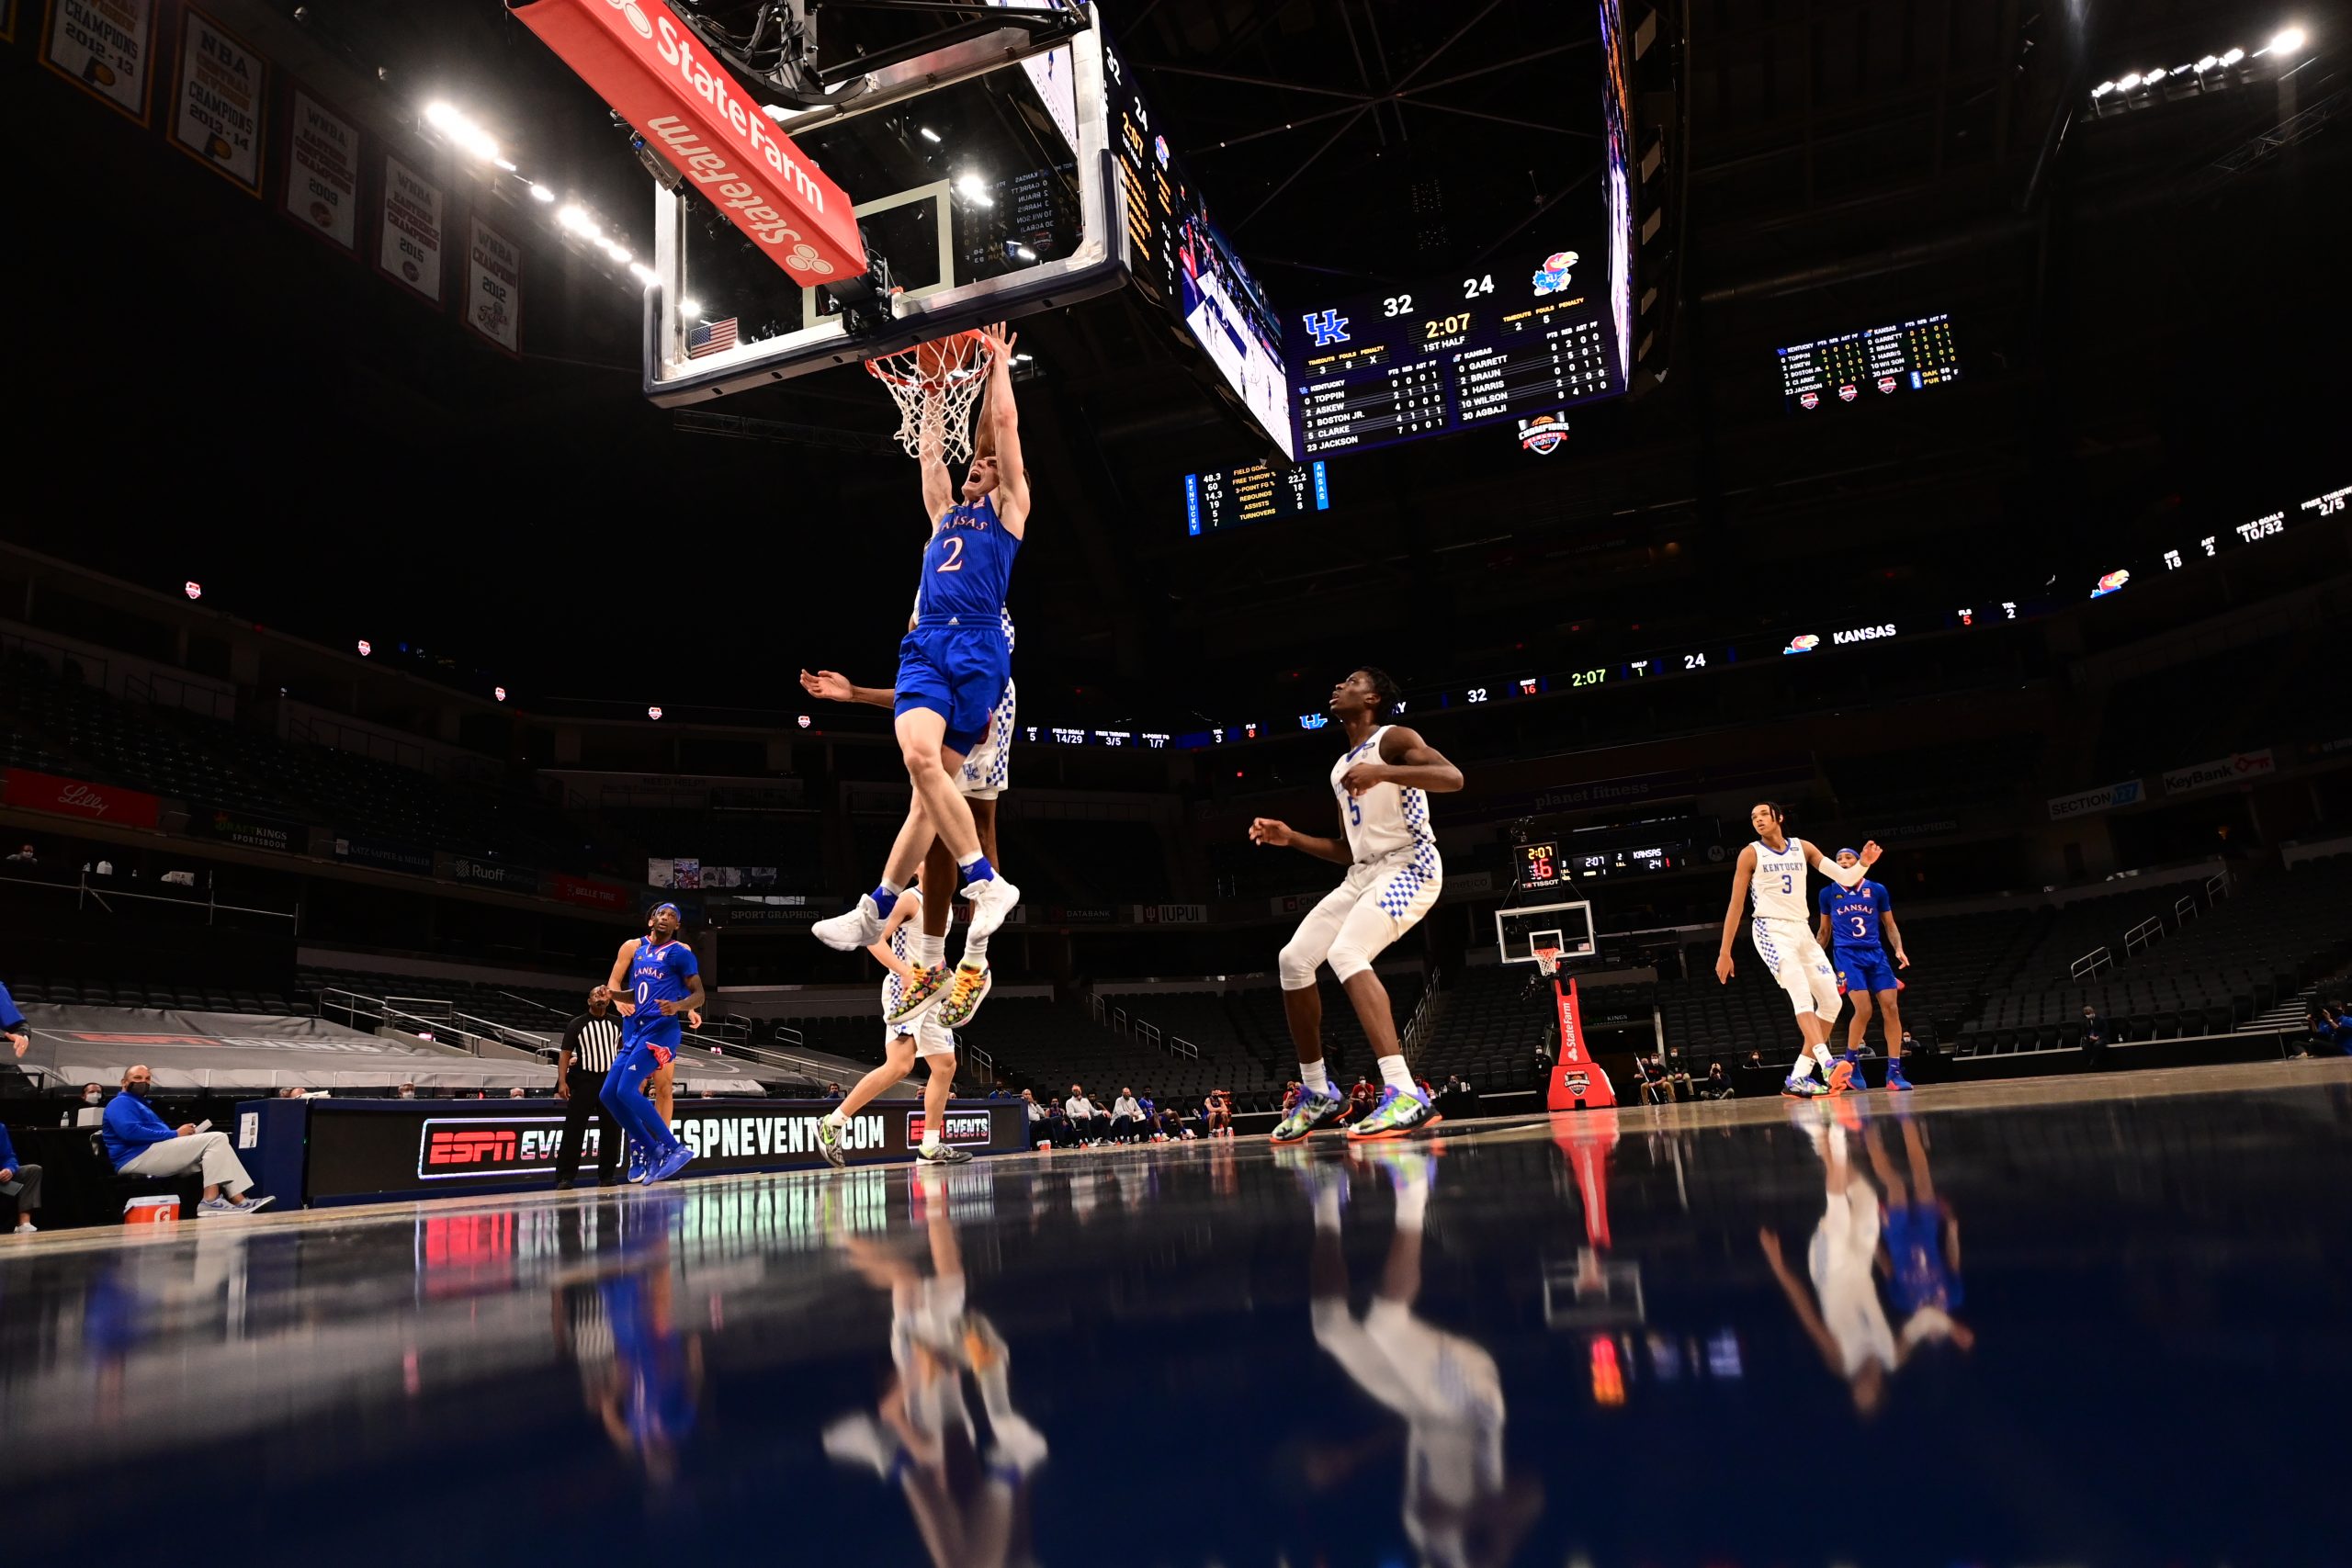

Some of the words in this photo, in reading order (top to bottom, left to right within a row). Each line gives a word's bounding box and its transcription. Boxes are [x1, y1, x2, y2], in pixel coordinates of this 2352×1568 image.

[65, 0, 138, 59] CHAMPIONS
[65, 22, 106, 59] 2012
[201, 30, 249, 80] NBA
[189, 81, 253, 134] CHAMPIONS
[190, 104, 223, 134] 2013
[1464, 275, 1495, 299] 24
[1383, 294, 1414, 318] 32
[1503, 311, 1532, 322] TIMEOUTS
[1535, 305, 1555, 314] FOULS
[1558, 298, 1584, 309] PENALTY
[1425, 313, 1470, 339] 2:07
[1515, 322, 1522, 331] 2
[1424, 342, 1440, 353] 1ST
[1442, 336, 1465, 348] HALF
[1464, 347, 1493, 359] KANSAS
[1308, 355, 1335, 366] TIMEOUTS
[1361, 345, 1384, 355] PENALTY
[1469, 355, 1508, 370] GARRETT
[1319, 366, 1326, 375] 3
[1471, 369, 1501, 382] BRAUN
[1310, 379, 1345, 392] KENTUCKY
[1472, 380, 1505, 394] HARRIS
[1315, 391, 1345, 403] TOPPIN
[1462, 400, 1472, 409] 10
[1474, 392, 1508, 406] WILSON
[1316, 402, 1345, 414] ASKEW
[1463, 412, 1474, 421] 30
[1476, 404, 1507, 418] AGBAJI
[1317, 413, 1351, 426] BOSTON
[1352, 411, 1365, 419] JR.
[1318, 425, 1351, 438] CLARKE
[1307, 444, 1317, 452] 23
[1319, 435, 1359, 449] JACKSON
[1232, 477, 1248, 485] FREE
[1249, 473, 1270, 482] THROW
[1234, 467, 1250, 476] FIELD
[1288, 473, 1306, 484] 22.2
[1235, 484, 1260, 493] 3-POINT
[1294, 483, 1304, 491] 18
[1205, 491, 1223, 501] 14.3
[1239, 491, 1272, 502] REBOUNDS
[1188, 479, 1197, 531] KENTUCKY
[1210, 501, 1219, 509] 19
[1244, 501, 1270, 510] ASSISTS
[2318, 498, 2345, 516] 2/5
[1239, 508, 1276, 520] TURNOVERS
[2236, 520, 2258, 534] FIELD
[2258, 512, 2284, 525] GOALS
[2301, 497, 2322, 510] FREE
[2165, 556, 2182, 570] 18
[2205, 545, 2215, 556] 2
[2243, 520, 2284, 543] 10/32
[937, 536, 963, 572] 2
[2007, 609, 2016, 619] 2
[1833, 624, 1896, 644] KANSAS
[1467, 689, 1487, 703] 32
[1522, 684, 1536, 695] 16
[1571, 669, 1606, 687] 2:07
[1684, 653, 1706, 670] 24
[1056, 734, 1082, 744] 14/29
[1106, 736, 1121, 746] 3/5
[1149, 739, 1163, 749] 1/7
[2165, 765, 2233, 790] KeyBank
[57, 784, 108, 817] Lilly
[1535, 790, 1589, 809] planet
[2052, 793, 2111, 816] SECTION
[1347, 796, 1361, 826] 5
[232, 833, 287, 850] SPORTSBOOK
[1528, 846, 1553, 860] 2:07
[1633, 849, 1662, 859] KANSAS
[1585, 856, 1604, 867] 2:07
[1649, 860, 1661, 869] 24
[1762, 863, 1804, 873] KENTUCKY
[472, 864, 504, 882] Ruoff
[1532, 879, 1559, 887] TISSOT
[1781, 874, 1792, 894] 3
[730, 910, 765, 919] SPORT
[767, 910, 820, 919] GRAPHICS
[1066, 910, 1111, 919] DATABANK
[1161, 907, 1199, 921] IUPUI
[1837, 904, 1873, 915] KANSAS
[1850, 917, 1866, 938] 3
[634, 966, 663, 979] KANSAS
[638, 981, 649, 1004] 0
[1563, 1002, 1577, 1047] StateFarm
[671, 1115, 885, 1158] ESPNEVENTCOM
[945, 1119, 989, 1138] EVENTS
[429, 1131, 516, 1164] ESPN
